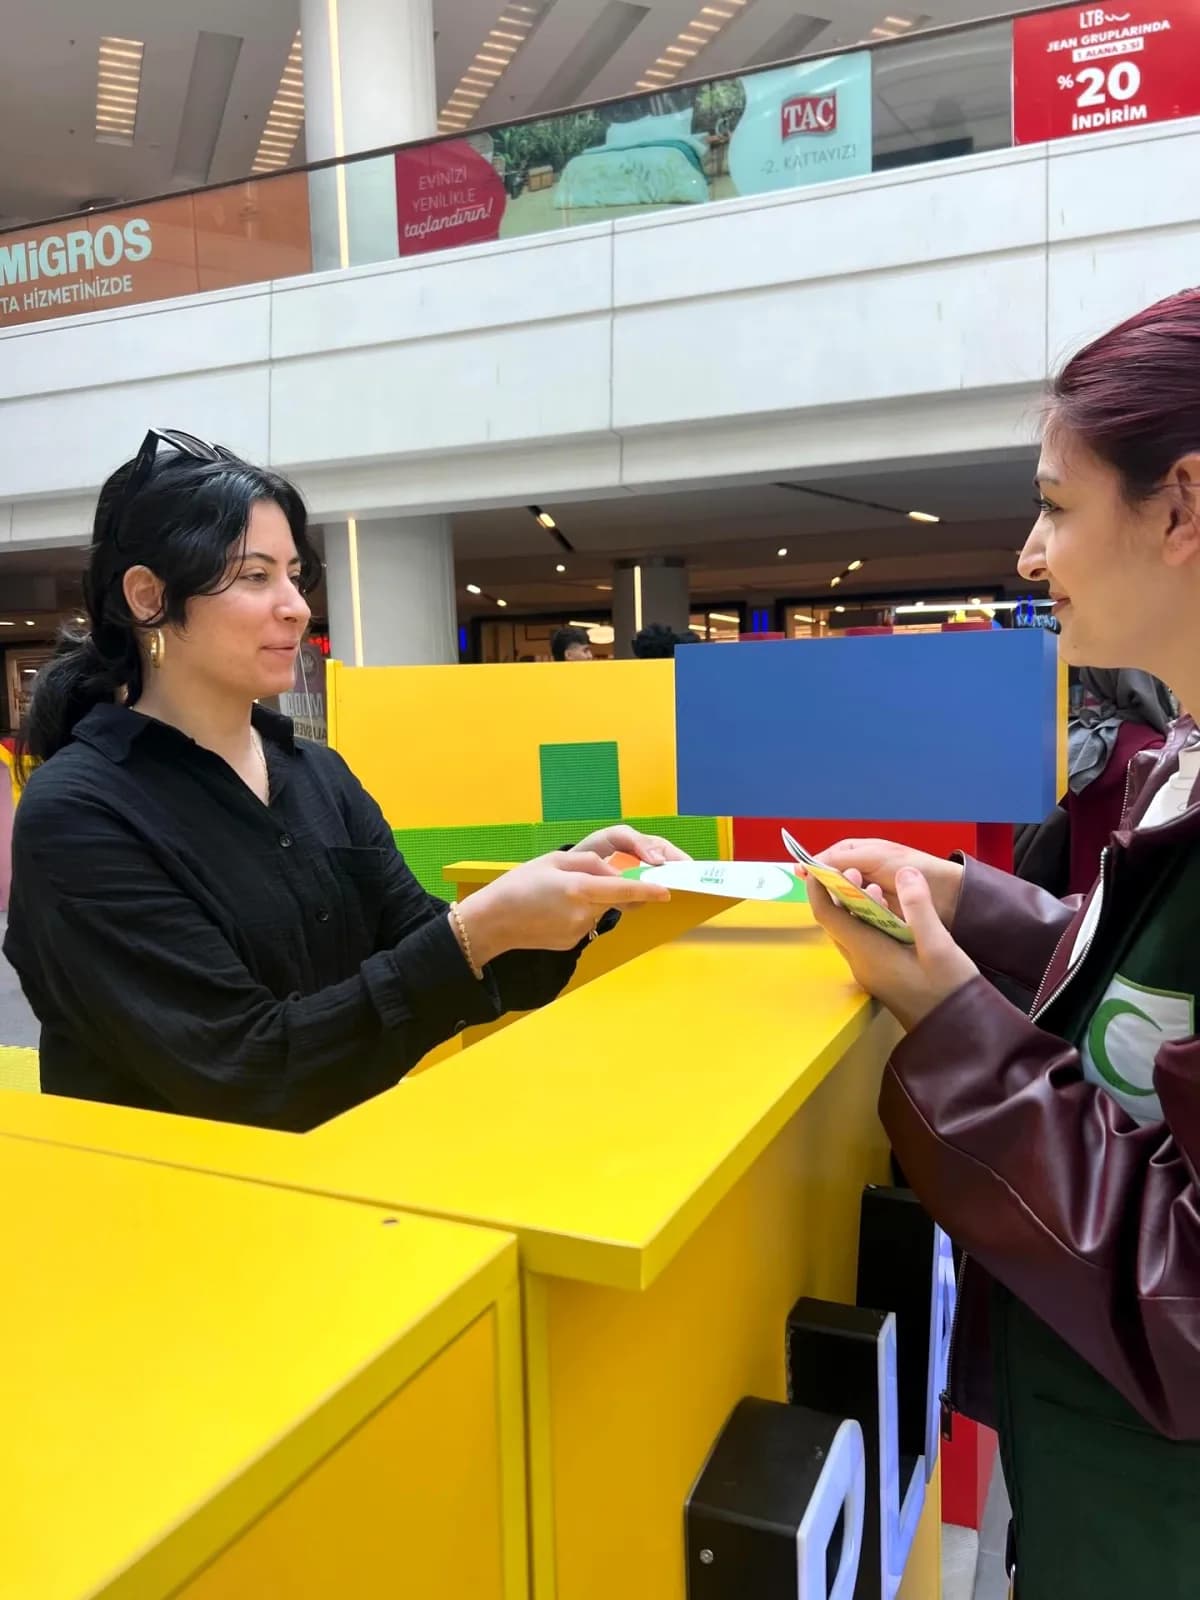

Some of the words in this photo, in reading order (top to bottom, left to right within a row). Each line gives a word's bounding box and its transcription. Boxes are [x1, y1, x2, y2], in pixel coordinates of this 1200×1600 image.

[1080, 9, 1104, 29] LTB
[1047, 38, 1077, 52] JEAN
[1081, 20, 1170, 45] GRUPLARINDA
[1086, 45, 1118, 57] ALANA
[1072, 104, 1147, 130] İNDİRİM
[784, 144, 856, 169] KATTAYIZ!
[23, 275, 133, 311] HİZMETİNİZDE
